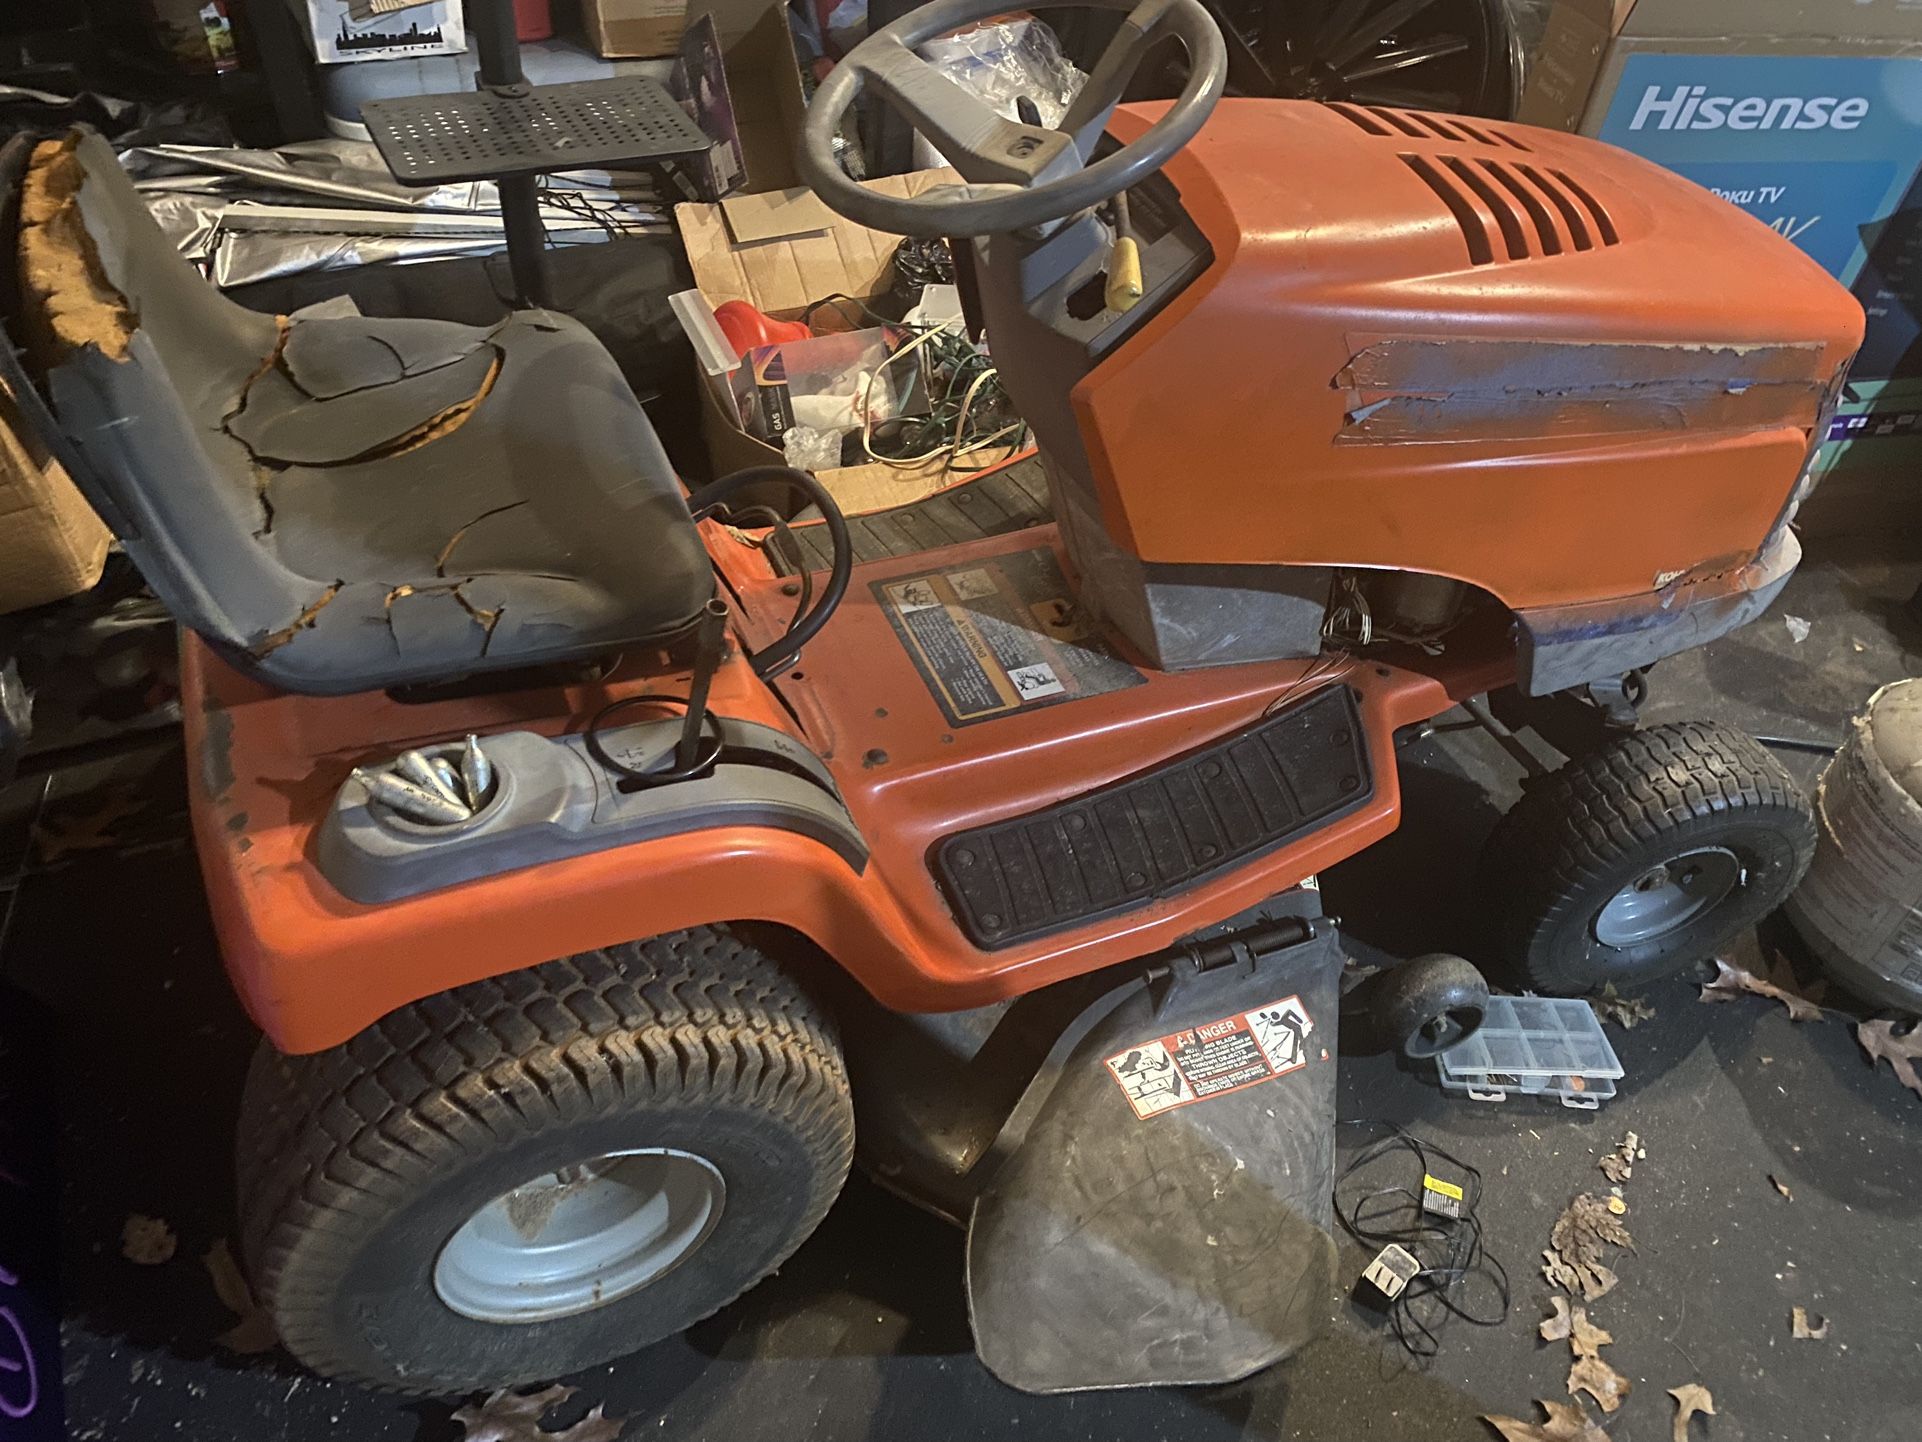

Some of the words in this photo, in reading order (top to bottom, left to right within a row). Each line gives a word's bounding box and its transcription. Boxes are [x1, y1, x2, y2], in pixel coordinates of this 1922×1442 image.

[339, 45, 443, 56] SKYLINE
[1629, 85, 1870, 131] Hisense
[1758, 186, 1787, 204] TV
[771, 412, 782, 431] GAS
[960, 622, 988, 661] WARNING
[1214, 1034, 1237, 1046] BLADE
